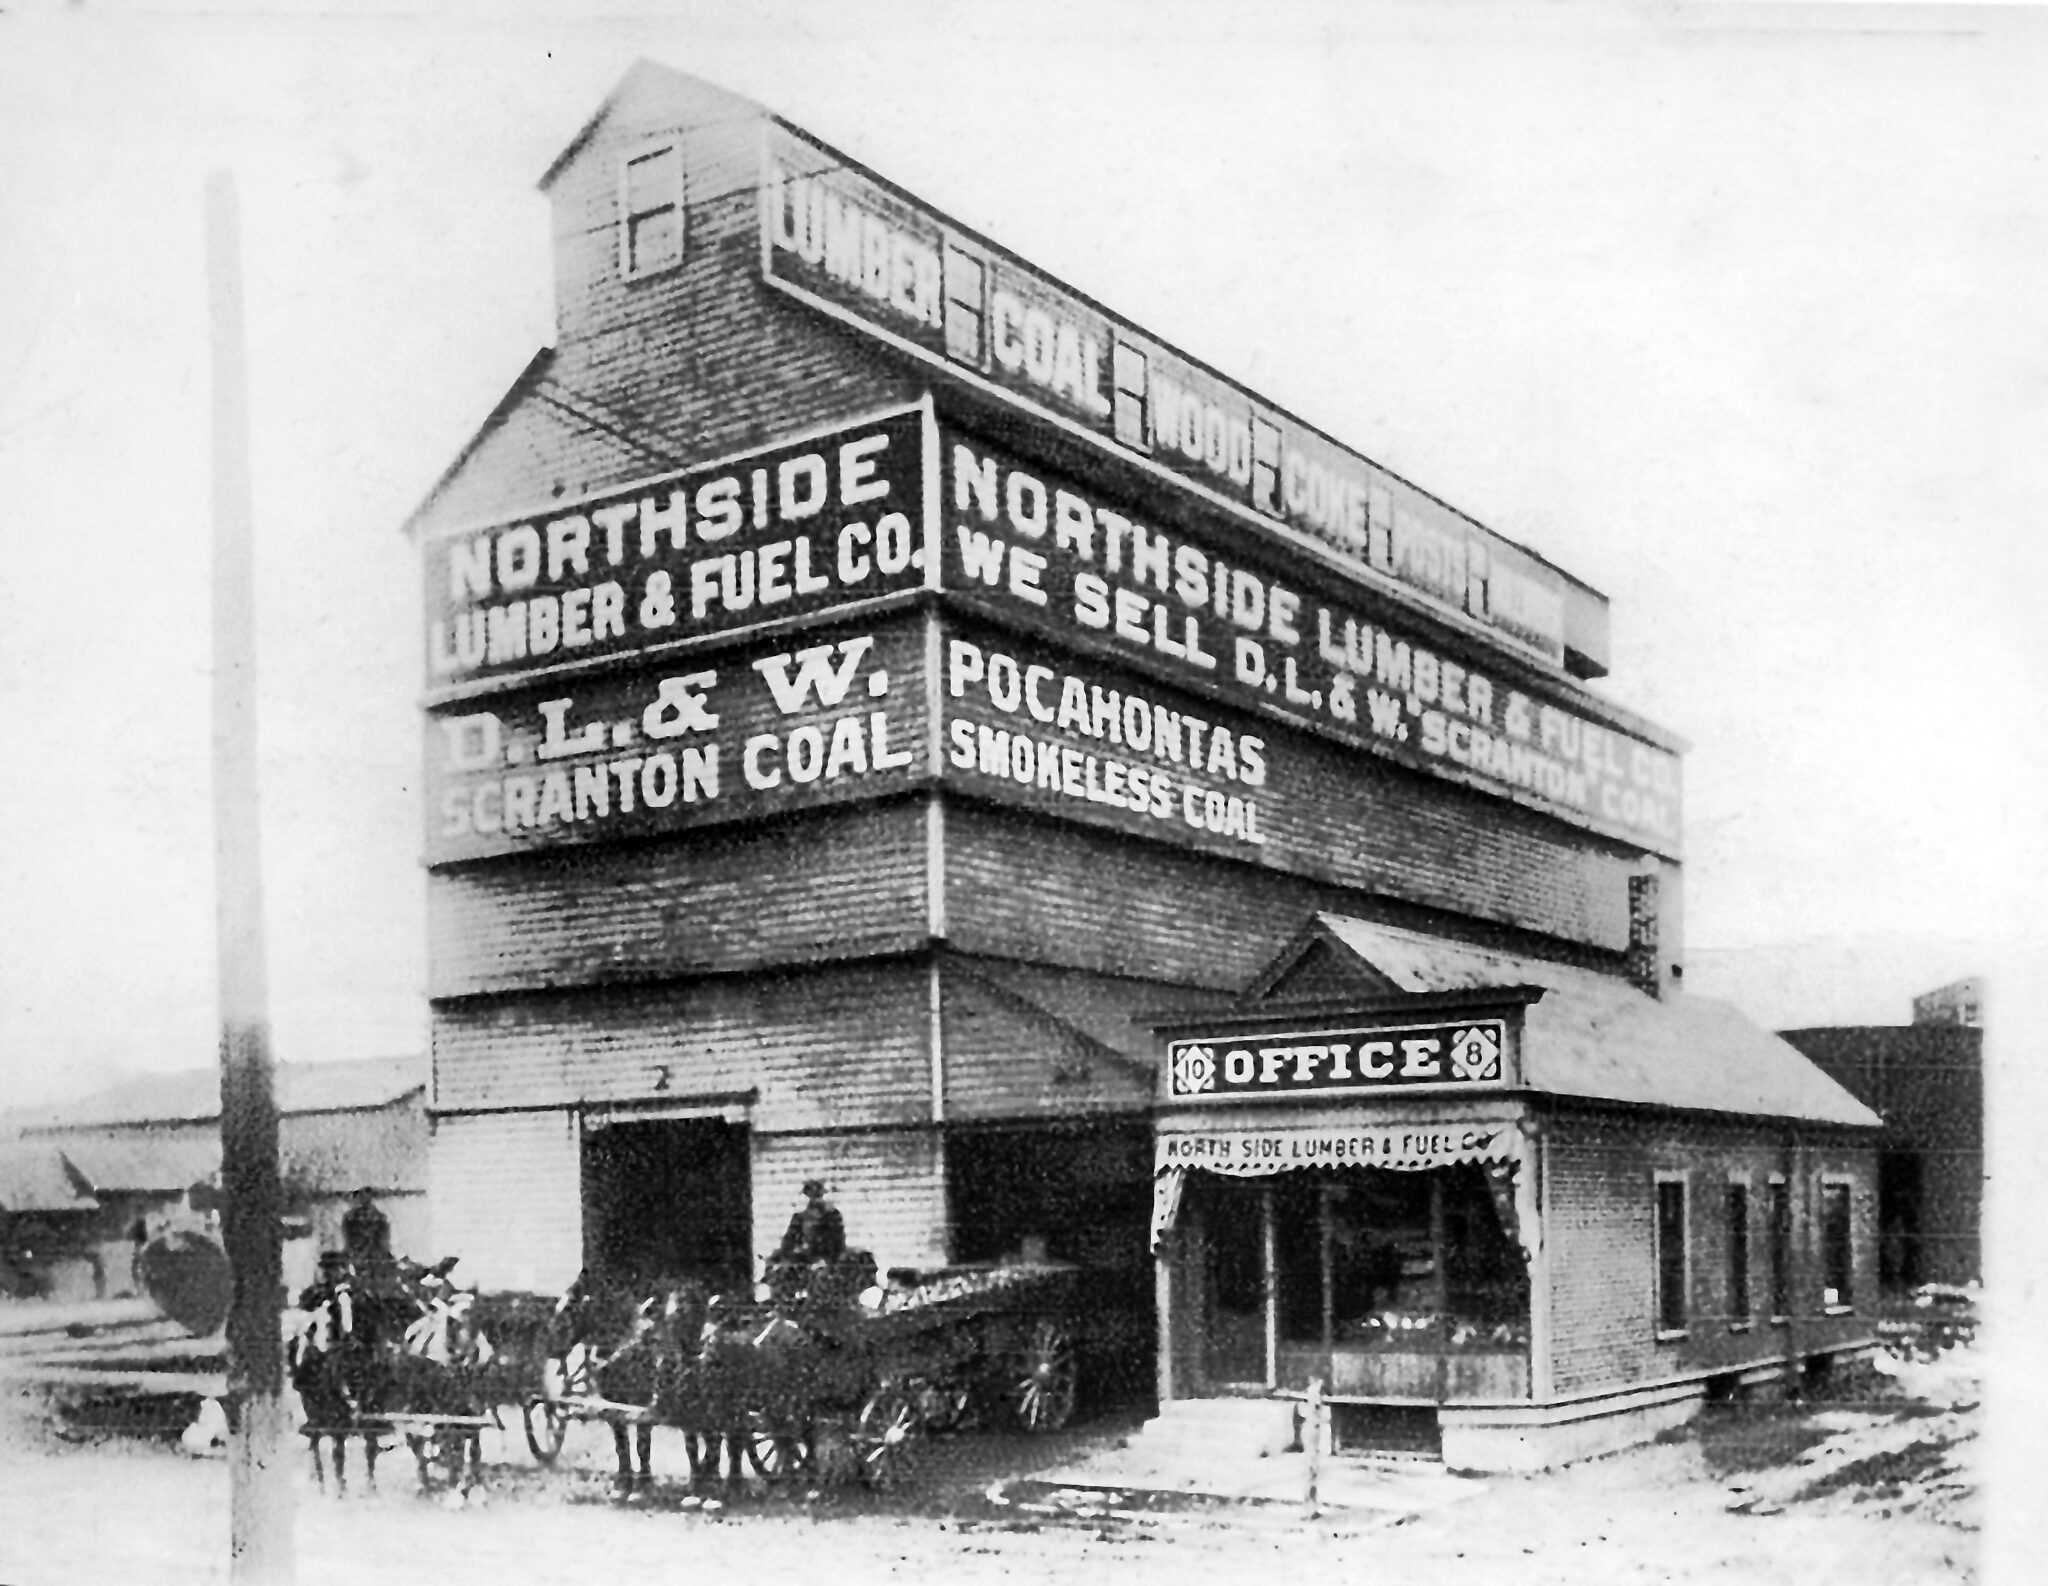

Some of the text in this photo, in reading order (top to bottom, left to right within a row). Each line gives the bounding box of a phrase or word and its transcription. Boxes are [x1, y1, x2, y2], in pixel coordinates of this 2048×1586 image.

[773, 172, 942, 328] LUMBER
[994, 292, 1111, 415] COAL
[1151, 372, 1253, 487] WOOD
[449, 434, 891, 601] NORTHSIDE
[431, 511, 926, 678] LUMBER & FUEL CO.
[953, 444, 1301, 646] NORTHSIDE
[1318, 607, 1494, 726] LUMBER
[1505, 690, 1531, 739] &
[1540, 705, 1625, 779] FUEL
[957, 525, 1048, 607] WE
[1074, 572, 1217, 669] SELL
[1329, 671, 1357, 723] &
[1366, 687, 1409, 742] W.
[643, 670, 720, 740] &
[752, 636, 889, 714] W.
[949, 639, 1266, 786] POCAHONTAS
[440, 711, 913, 837] SCRANTON COAL
[950, 718, 1267, 845] SMOKELESS COAL
[1183, 1039, 1482, 1083] 10 OFFICE 8
[1167, 1138, 1231, 1158] NORTH
[1241, 1138, 1283, 1159] SIDE
[1292, 1136, 1375, 1159] LUMBER
[1403, 1133, 1455, 1156] FUEL
